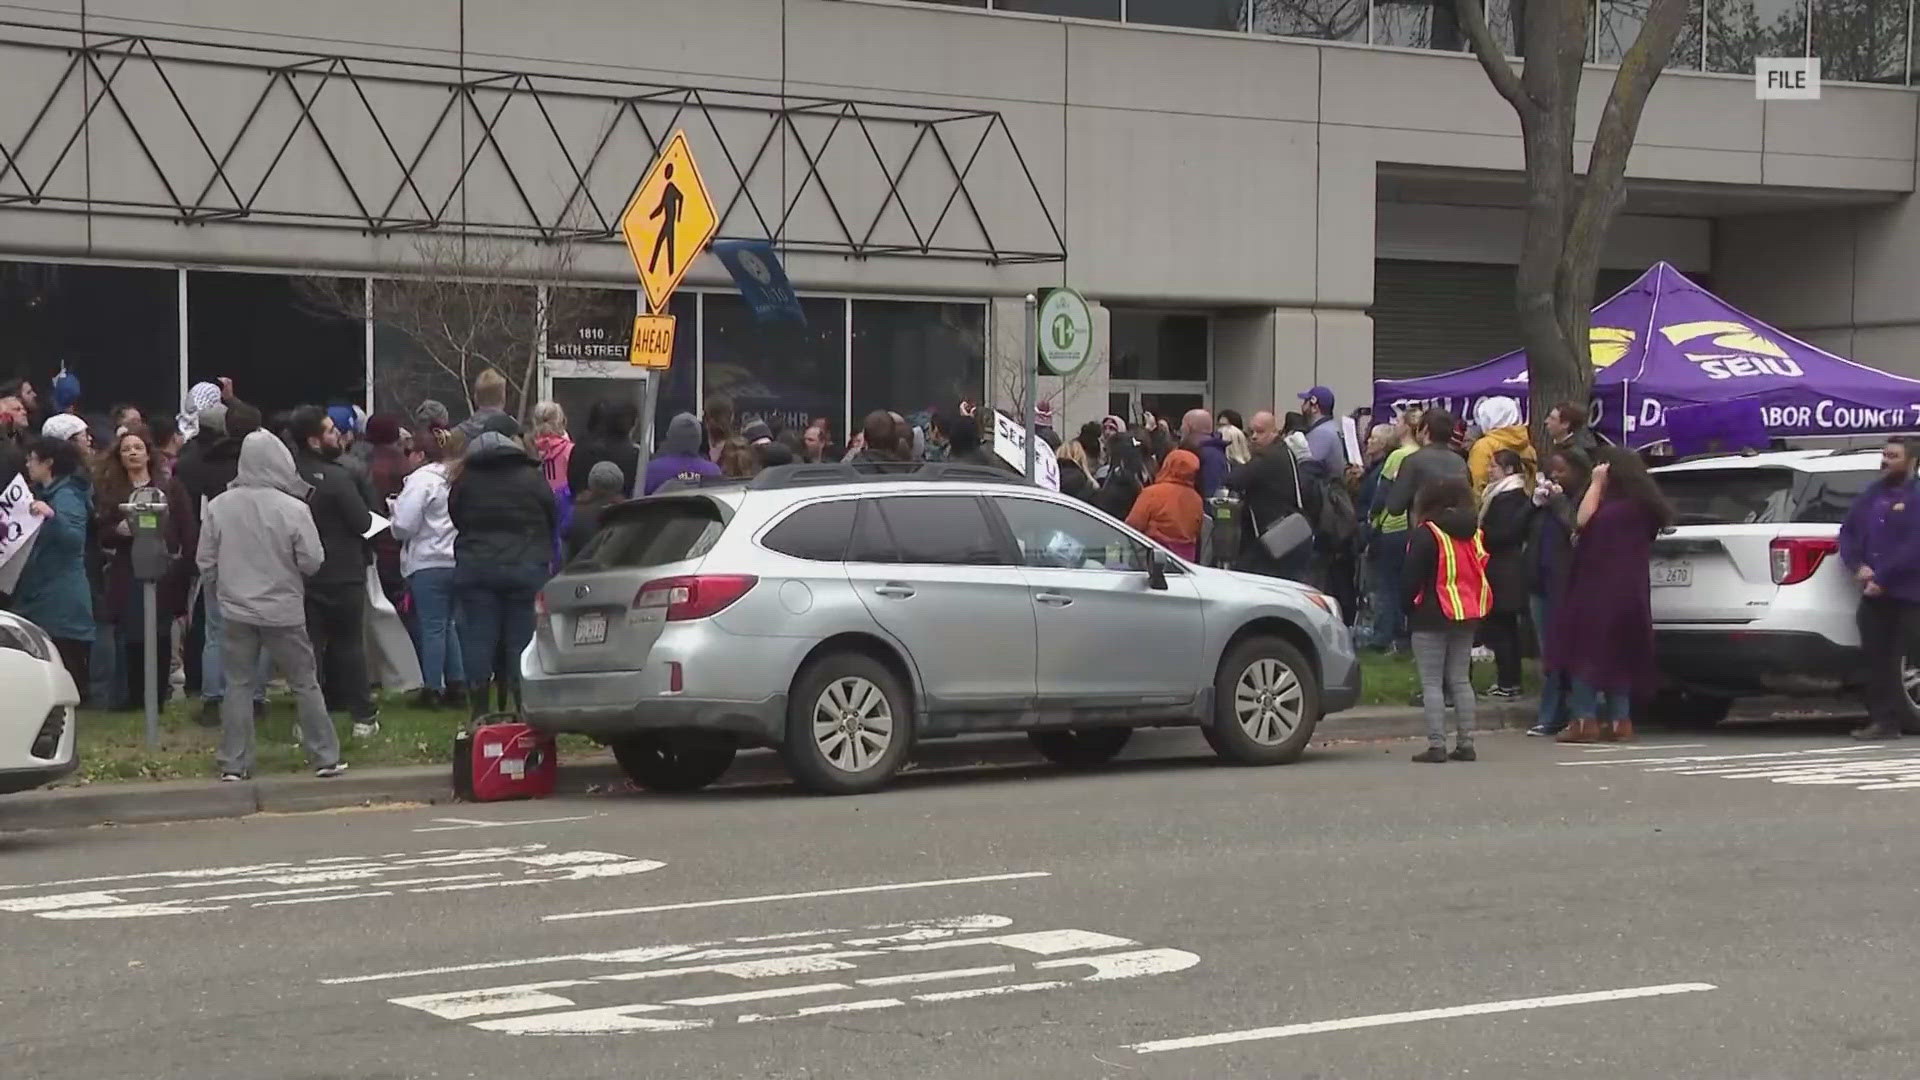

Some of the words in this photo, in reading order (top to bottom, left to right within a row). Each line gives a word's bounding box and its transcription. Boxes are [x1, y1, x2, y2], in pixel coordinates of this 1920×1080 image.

[579, 328, 605, 339] 1810
[634, 329, 671, 354] AHEAD
[553, 343, 582, 356] 16TH
[584, 345, 629, 357] STREET
[1699, 357, 1804, 380] SEIU
[1815, 400, 1905, 428] COUNCIL
